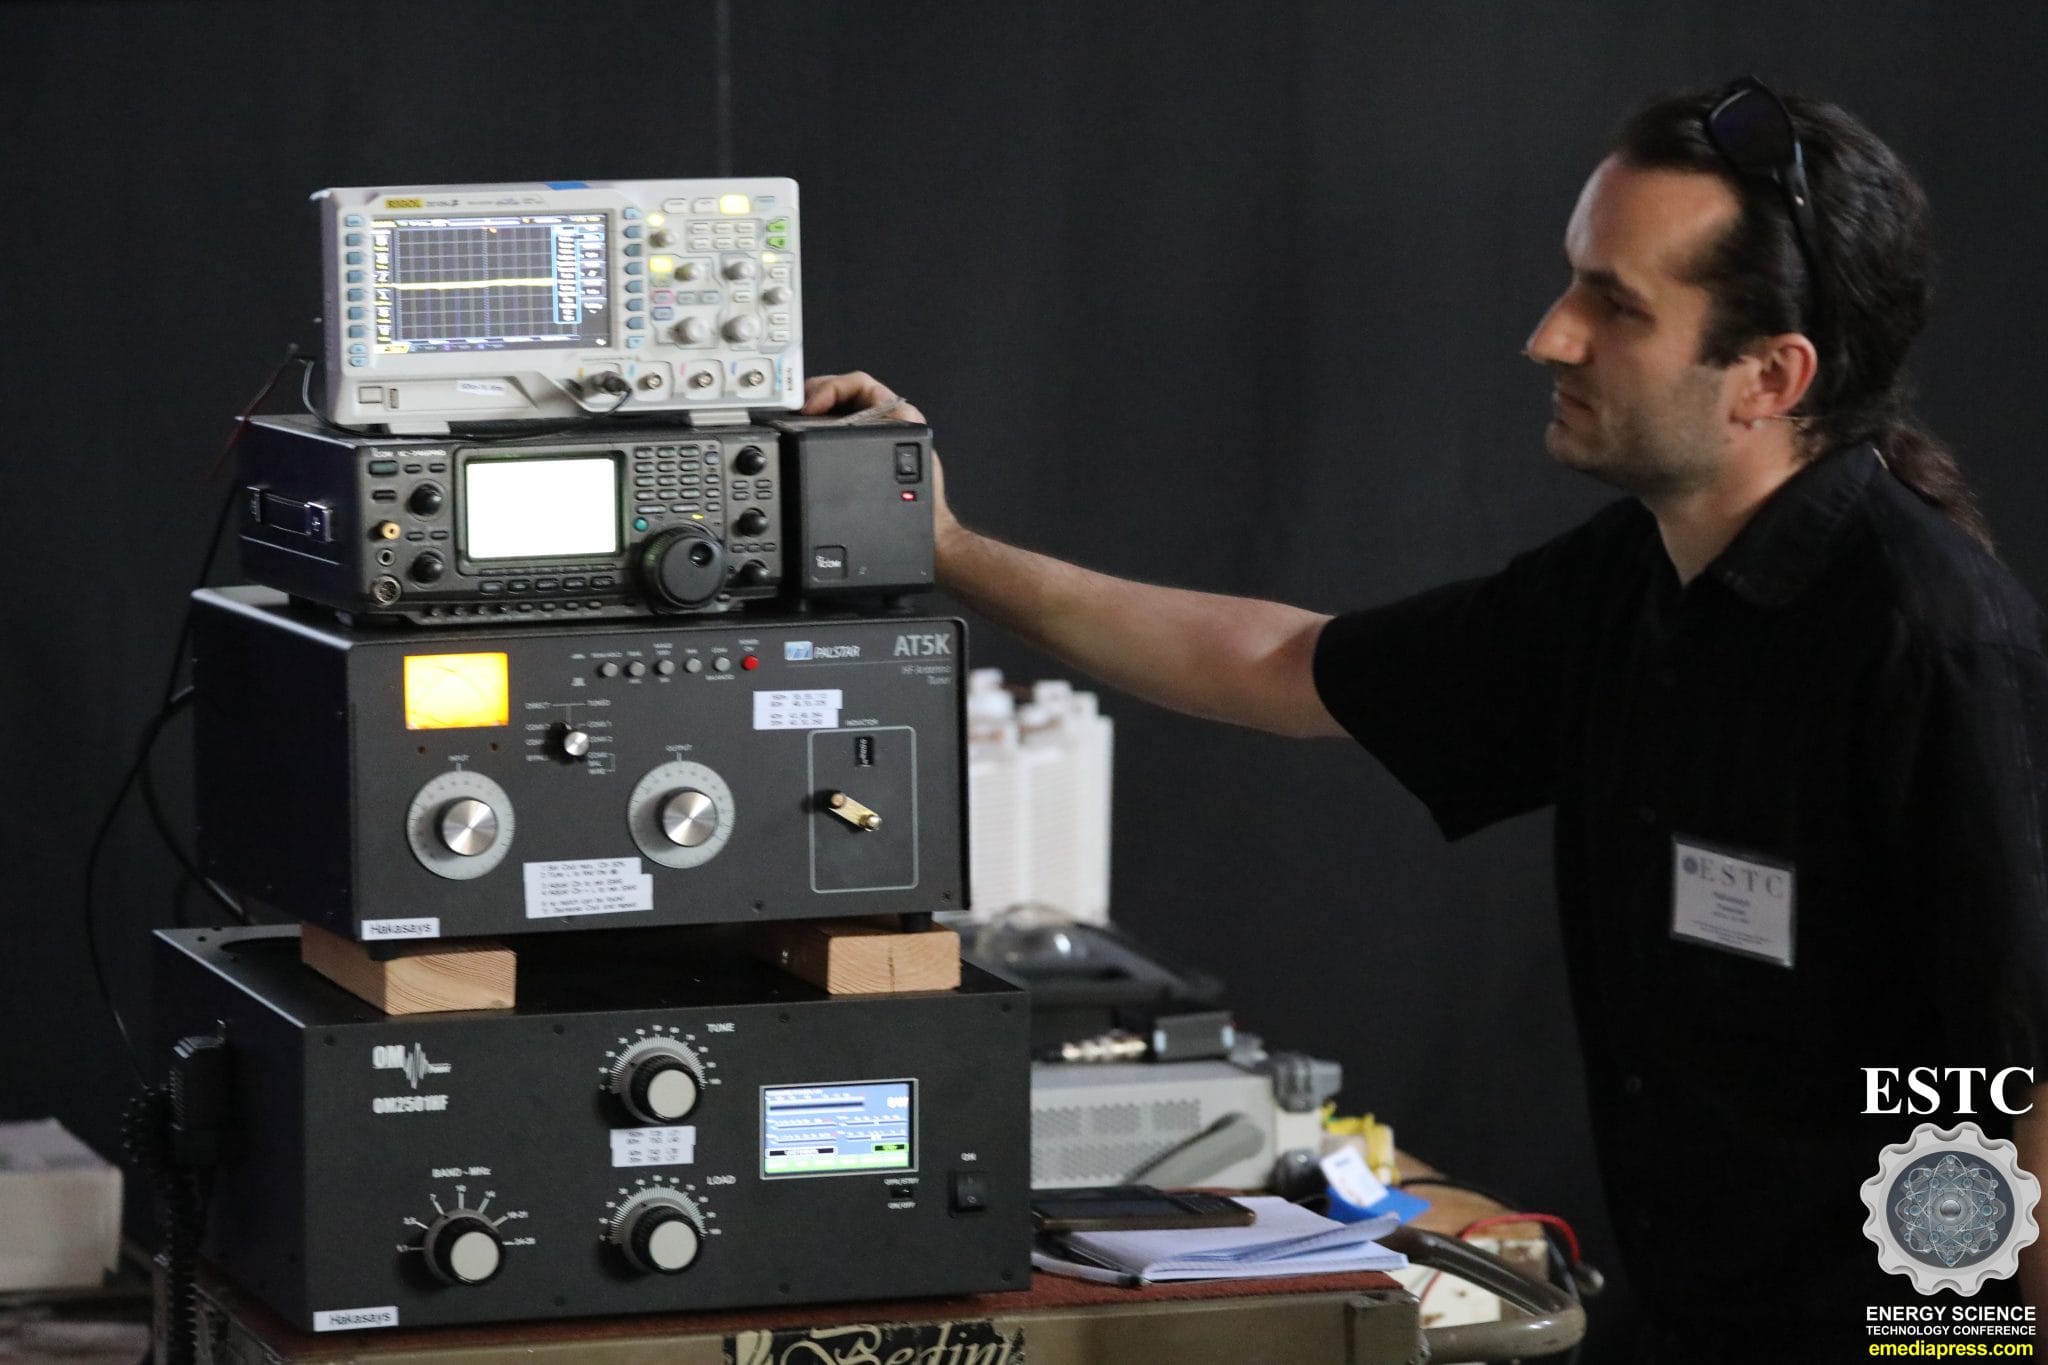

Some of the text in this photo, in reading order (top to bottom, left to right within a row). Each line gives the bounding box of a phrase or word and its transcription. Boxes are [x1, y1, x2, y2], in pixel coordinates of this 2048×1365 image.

[893, 633, 952, 656] AT5K
[814, 645, 861, 659] PALSTAR
[706, 1022, 735, 1033] TUNE
[706, 1175, 737, 1185] LOAD
